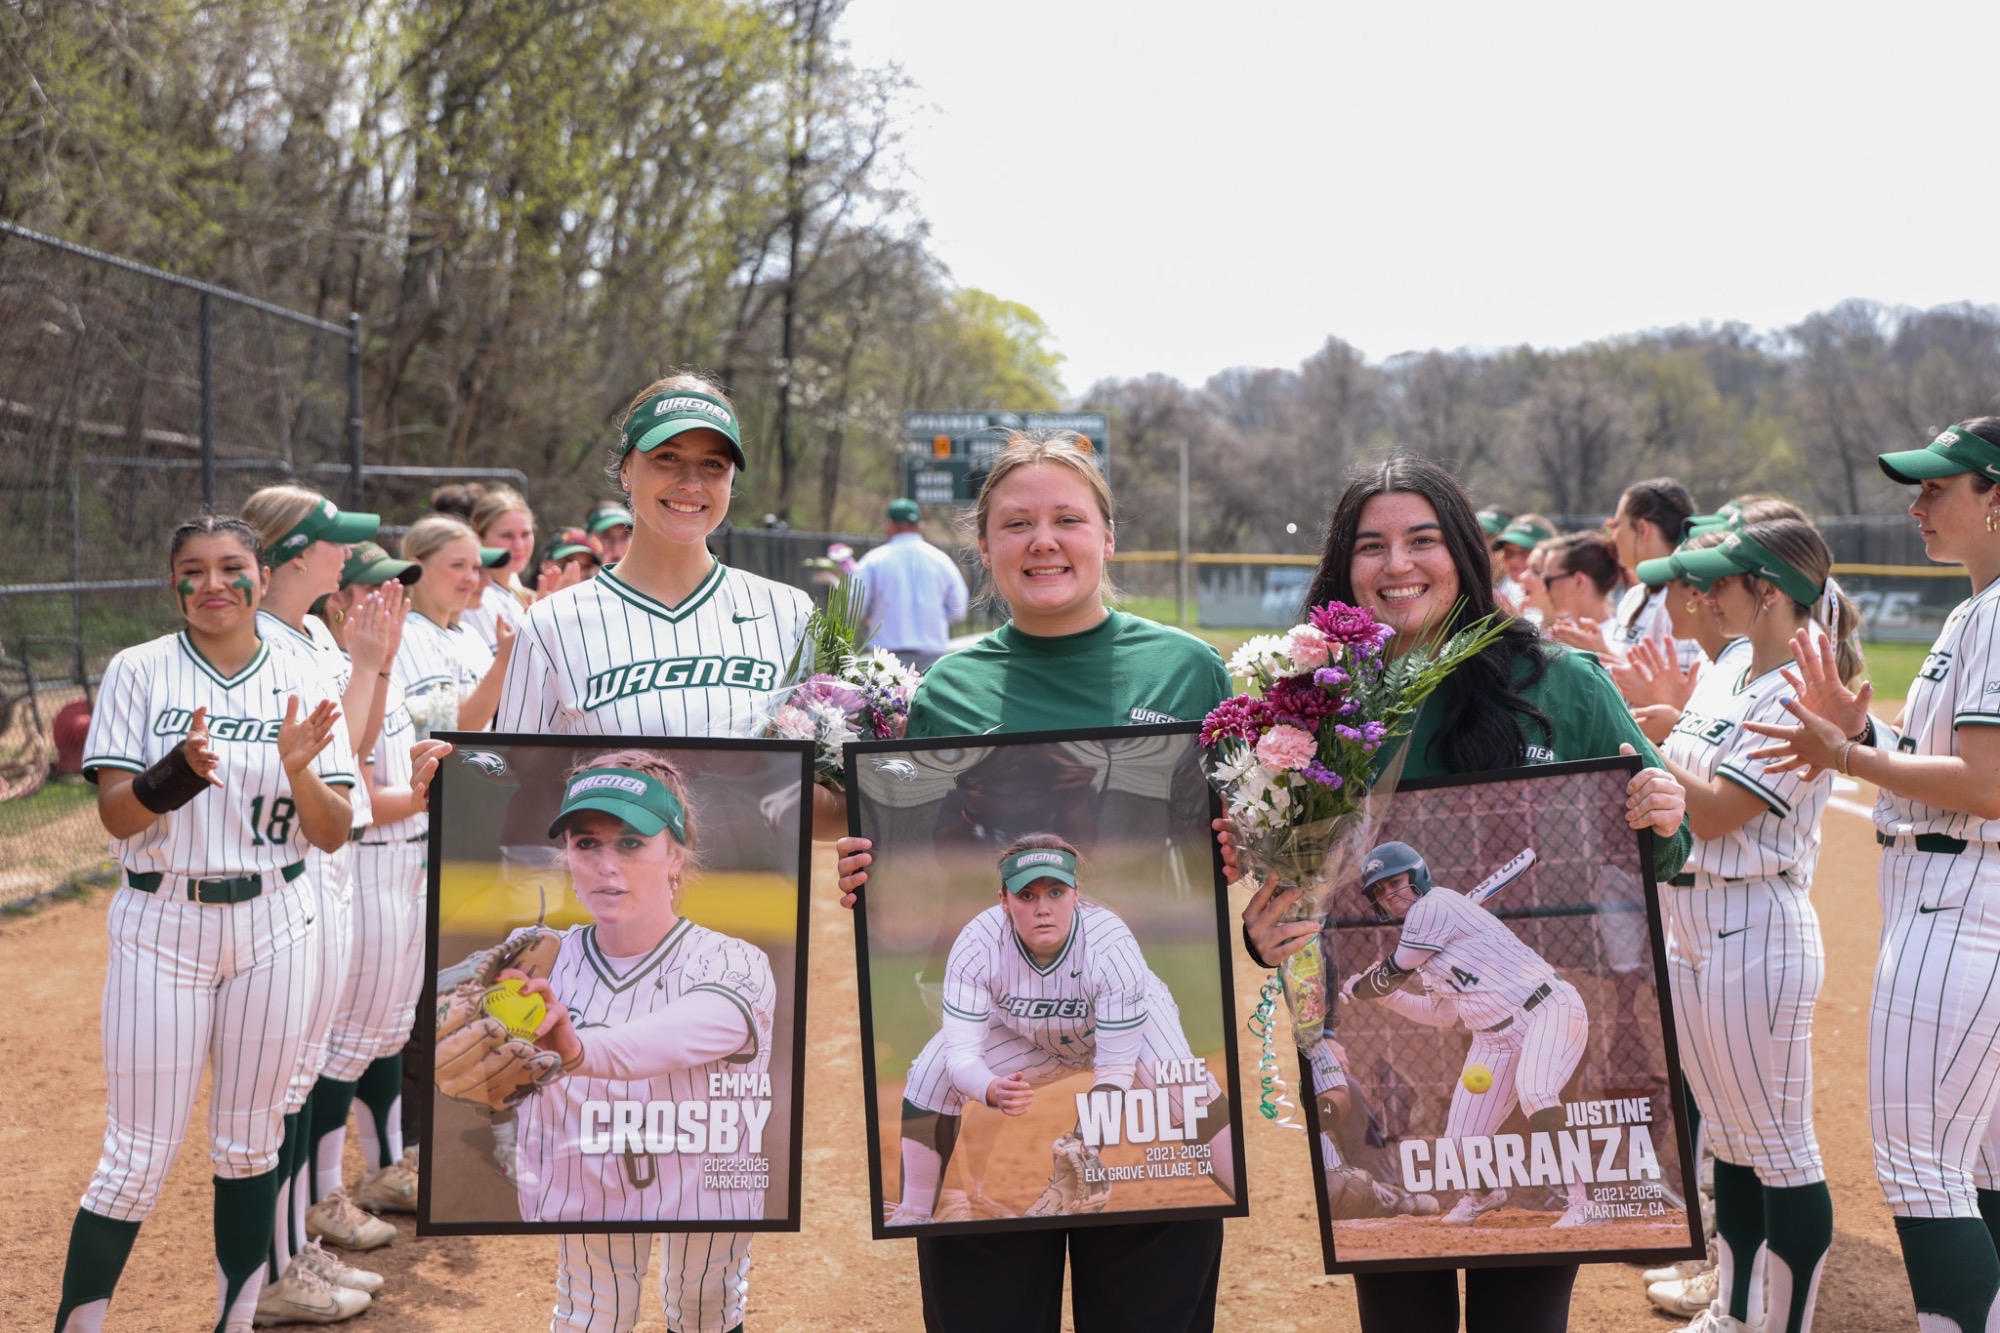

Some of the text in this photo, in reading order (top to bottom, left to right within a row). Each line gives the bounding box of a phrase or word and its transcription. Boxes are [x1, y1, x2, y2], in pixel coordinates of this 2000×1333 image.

[654, 397, 731, 427] WAGNER
[584, 656, 776, 711] WAGNER
[569, 774, 648, 800] WAGNER
[251, 795, 296, 846] 18
[1016, 853, 1064, 868] WAGNER
[1154, 1057, 1207, 1085] KATE
[709, 1073, 772, 1097] EMMA
[1076, 1085, 1209, 1147] WOLF
[1565, 1097, 1653, 1127] JUSTINE
[580, 1100, 772, 1154] CROSBY
[704, 1158, 769, 1172] 2022-2025
[1146, 1144, 1211, 1162] 2021-2025
[1400, 1125, 1661, 1193] CARRANZA
[704, 1175, 769, 1190] PARKER, CO
[1085, 1161, 1214, 1183] ELK GROVE VILLAGE, CA
[1594, 1185, 1662, 1201] 2021-2025
[1583, 1202, 1666, 1219] MARTINEZ, CA
